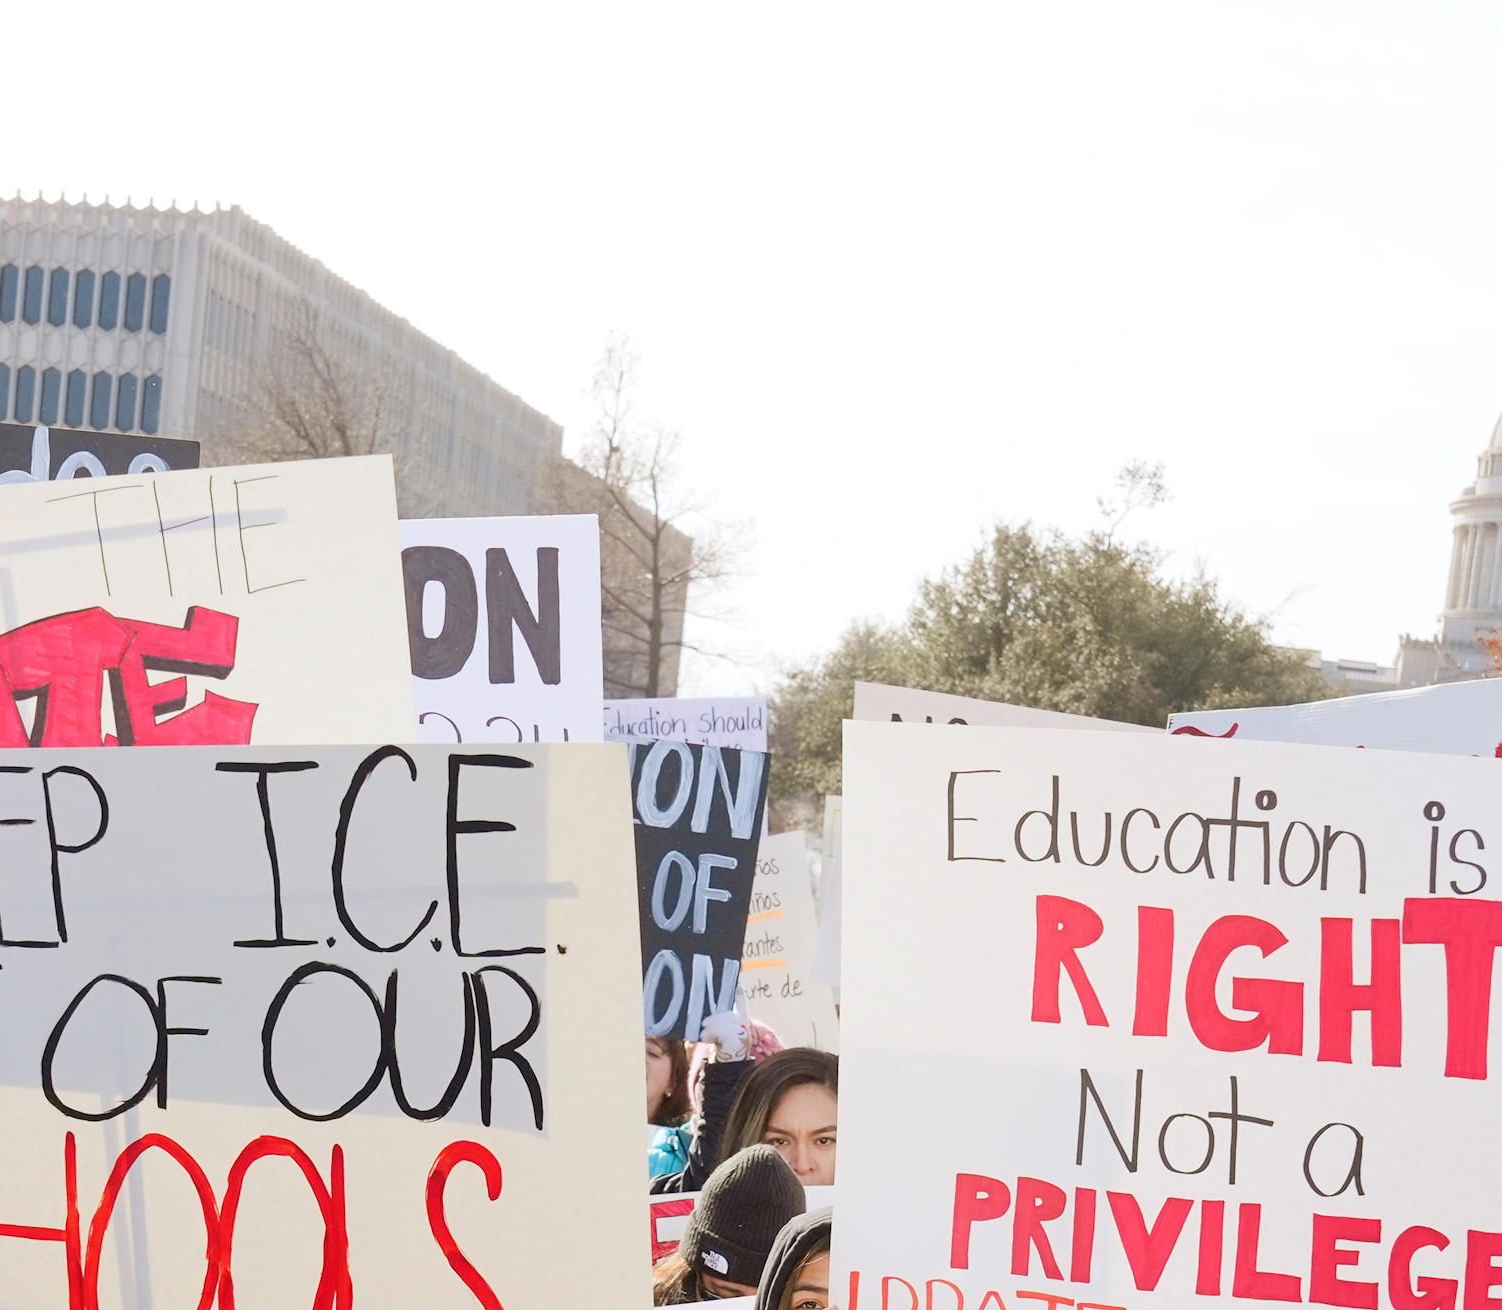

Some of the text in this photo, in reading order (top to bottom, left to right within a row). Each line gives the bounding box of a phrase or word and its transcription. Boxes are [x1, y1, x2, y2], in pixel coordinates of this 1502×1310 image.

[46, 474, 306, 597] THE
[215, 743, 568, 958] I.C.E.
[652, 850, 738, 934] OF
[946, 769, 1367, 895] Education
[1424, 800, 1489, 895] is
[743, 931, 785, 959] antes
[748, 891, 782, 917] iños
[40, 973, 222, 1122] OF
[262, 960, 545, 1130] OUR
[781, 973, 804, 998] de
[1076, 1067, 1366, 1197] Not a
